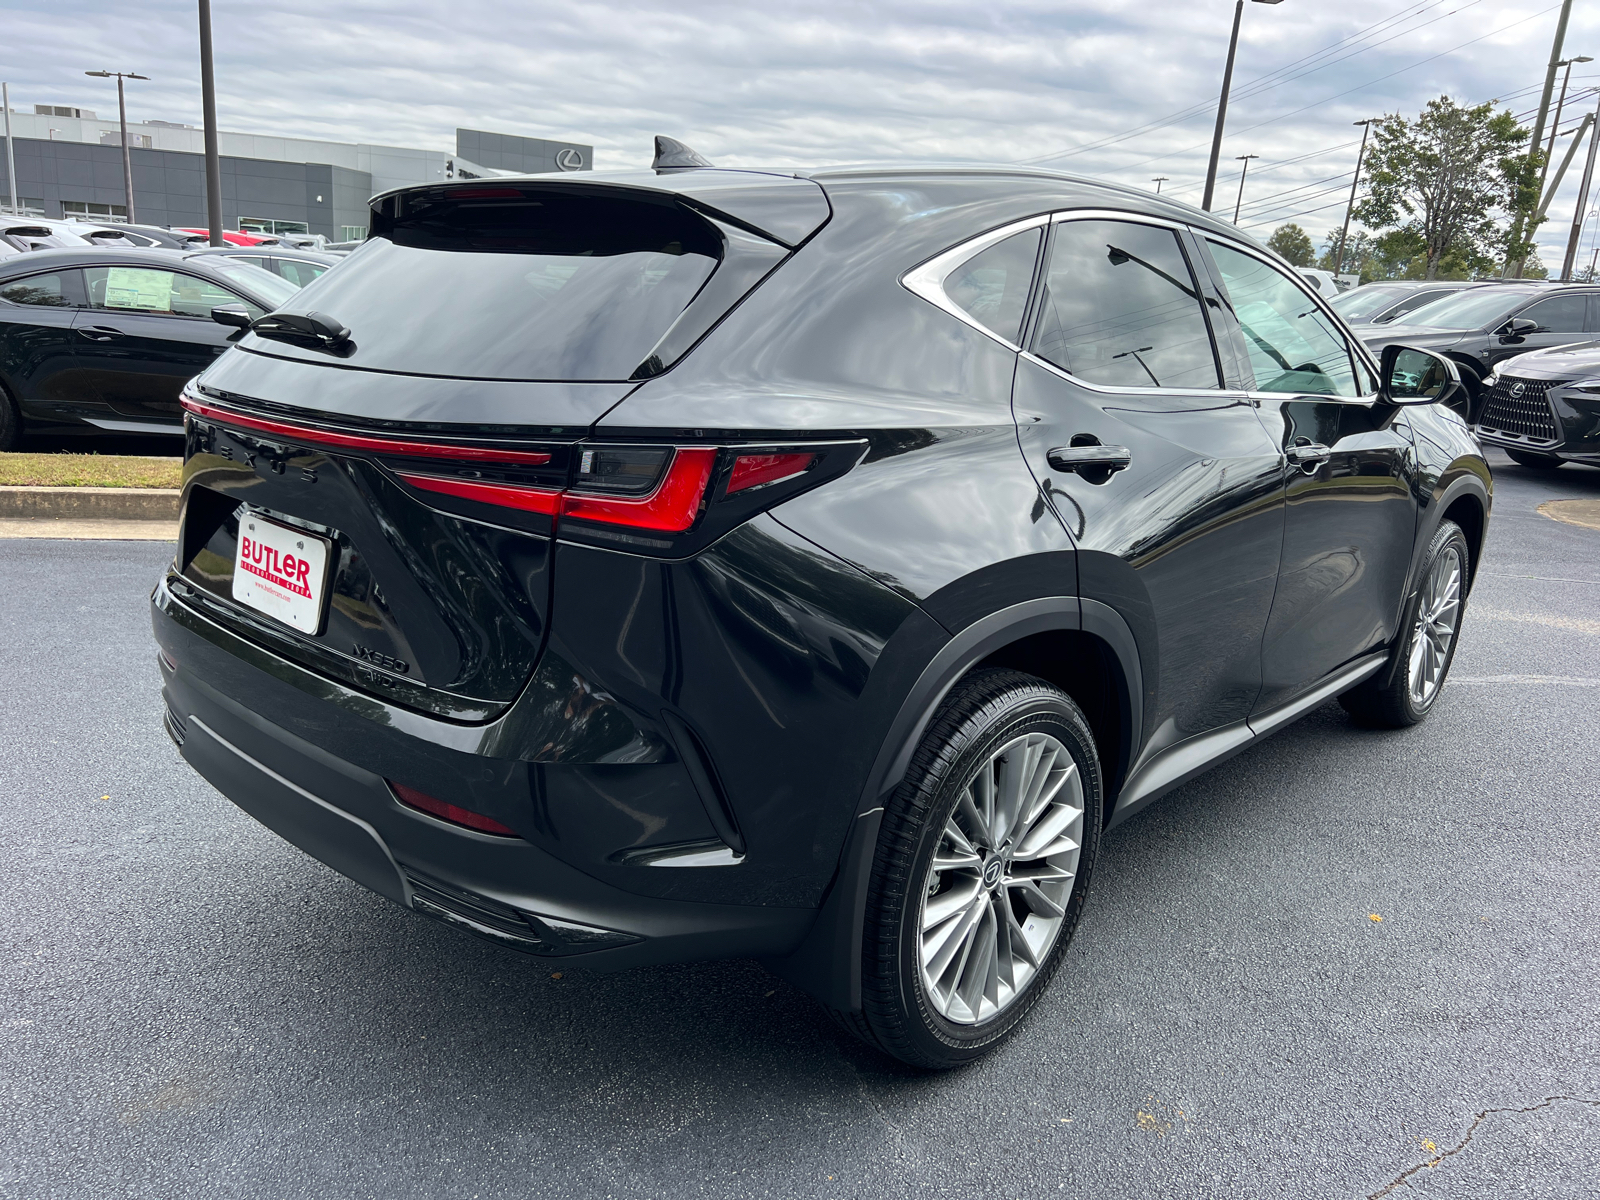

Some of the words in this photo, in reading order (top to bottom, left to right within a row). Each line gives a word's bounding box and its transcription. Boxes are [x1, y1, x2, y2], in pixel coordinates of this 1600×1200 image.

[200, 438, 318, 483] LEXUS
[254, 581, 291, 603] www.butlercars.com
[285, 581, 311, 598] GROUP
[353, 643, 409, 673] NX350
